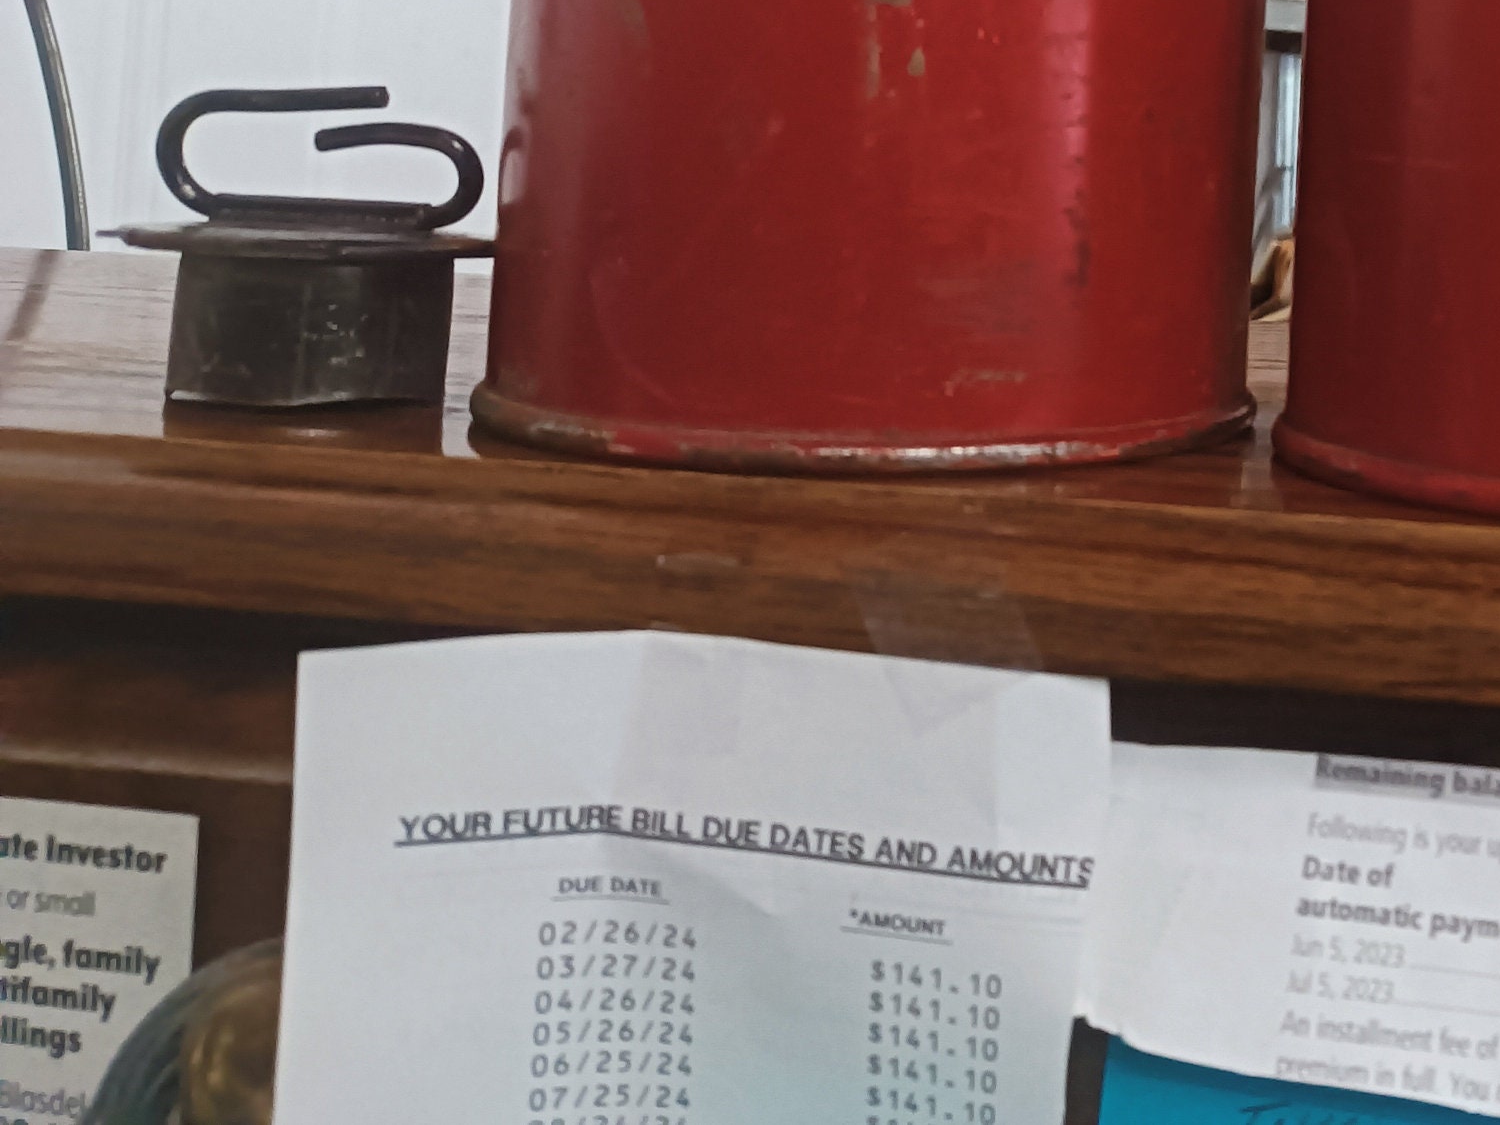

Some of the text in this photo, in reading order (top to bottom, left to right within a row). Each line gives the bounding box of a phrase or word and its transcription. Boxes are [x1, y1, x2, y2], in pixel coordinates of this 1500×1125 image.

[1316, 755, 1446, 799] Remaining
[47, 834, 168, 873] Investor
[398, 804, 1096, 888] YOUR FUTURE BILL DUE DATES AND AMOUNTS
[1307, 812, 1408, 855] Following
[1434, 833, 1482, 859] your
[558, 876, 662, 897] DUE DATE
[1302, 854, 1395, 890] Date of
[1296, 896, 1424, 931] automatic
[538, 919, 697, 950] 02/26/24
[63, 938, 162, 985] family
[536, 953, 696, 982] 03/27/24
[870, 959, 1003, 1000] $141.10
[534, 987, 695, 1016] 04/26/24
[869, 989, 1001, 1031] $141.10
[532, 1018, 693, 1047] 05/26/24
[868, 1021, 1000, 1063] $141.10
[530, 1049, 692, 1078] 06/25/24
[866, 1053, 998, 1094] $141.10
[528, 1082, 690, 1112] 07/25/24
[866, 1084, 997, 1125] $141.10
